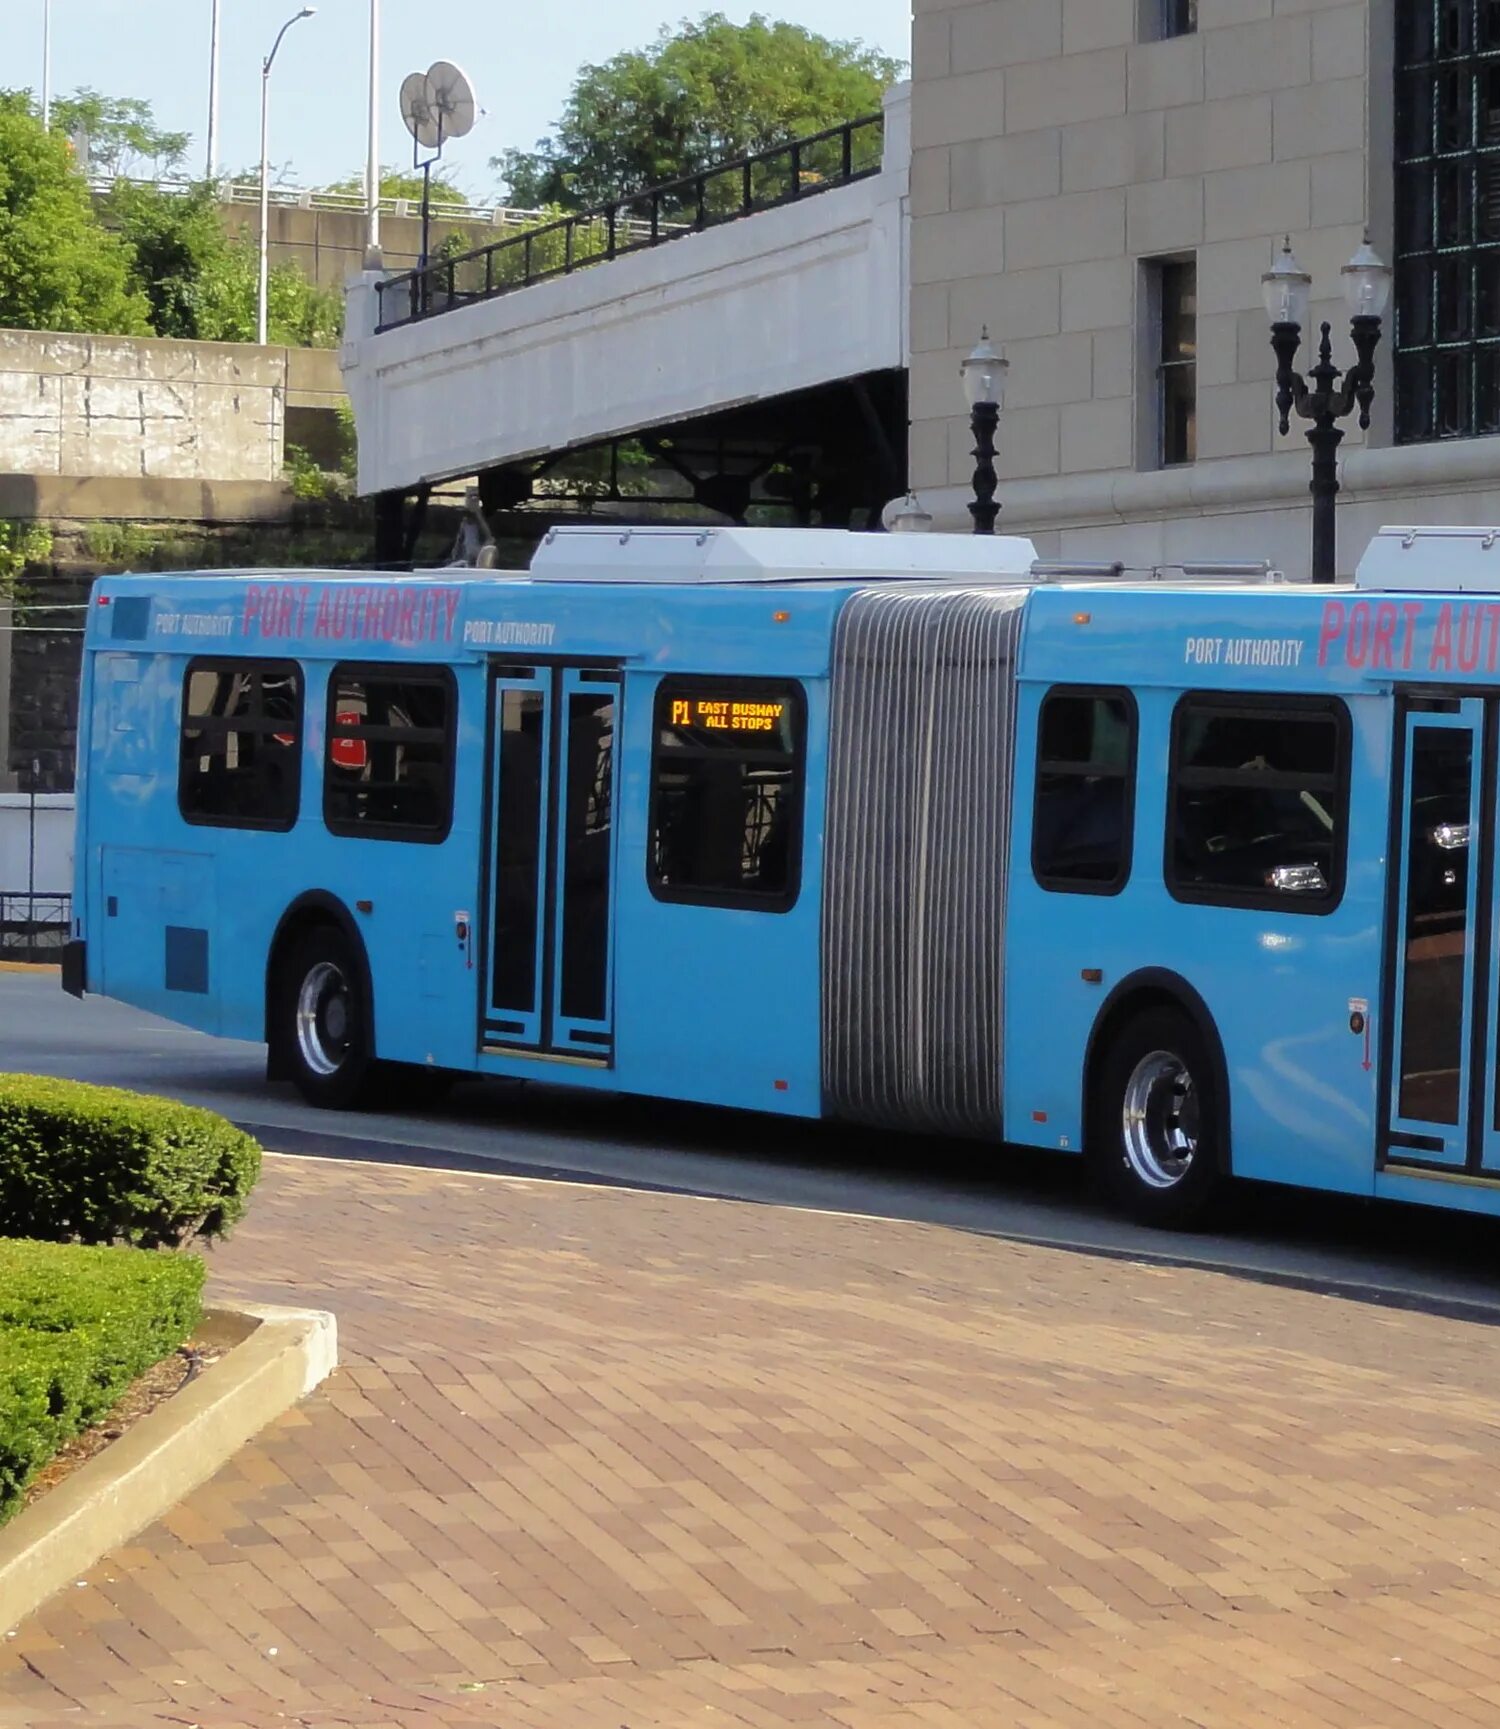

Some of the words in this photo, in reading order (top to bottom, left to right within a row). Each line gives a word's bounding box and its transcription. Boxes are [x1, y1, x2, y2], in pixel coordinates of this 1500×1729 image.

[156, 613, 180, 635] PORT
[181, 614, 235, 637] AUTHORITY
[242, 584, 311, 639] PORT
[315, 586, 462, 642] AUTHORITY
[463, 620, 493, 643] PORT
[495, 622, 556, 646] AUTHORITY
[1317, 600, 1423, 671] PORT
[1185, 637, 1223, 664] PORT
[1224, 638, 1304, 667] AUTHORITY
[672, 700, 690, 725] P1
[698, 702, 730, 715] EAST
[732, 703, 783, 717] BUSWAY
[706, 716, 728, 729] ALL
[731, 717, 773, 730] STOPS
